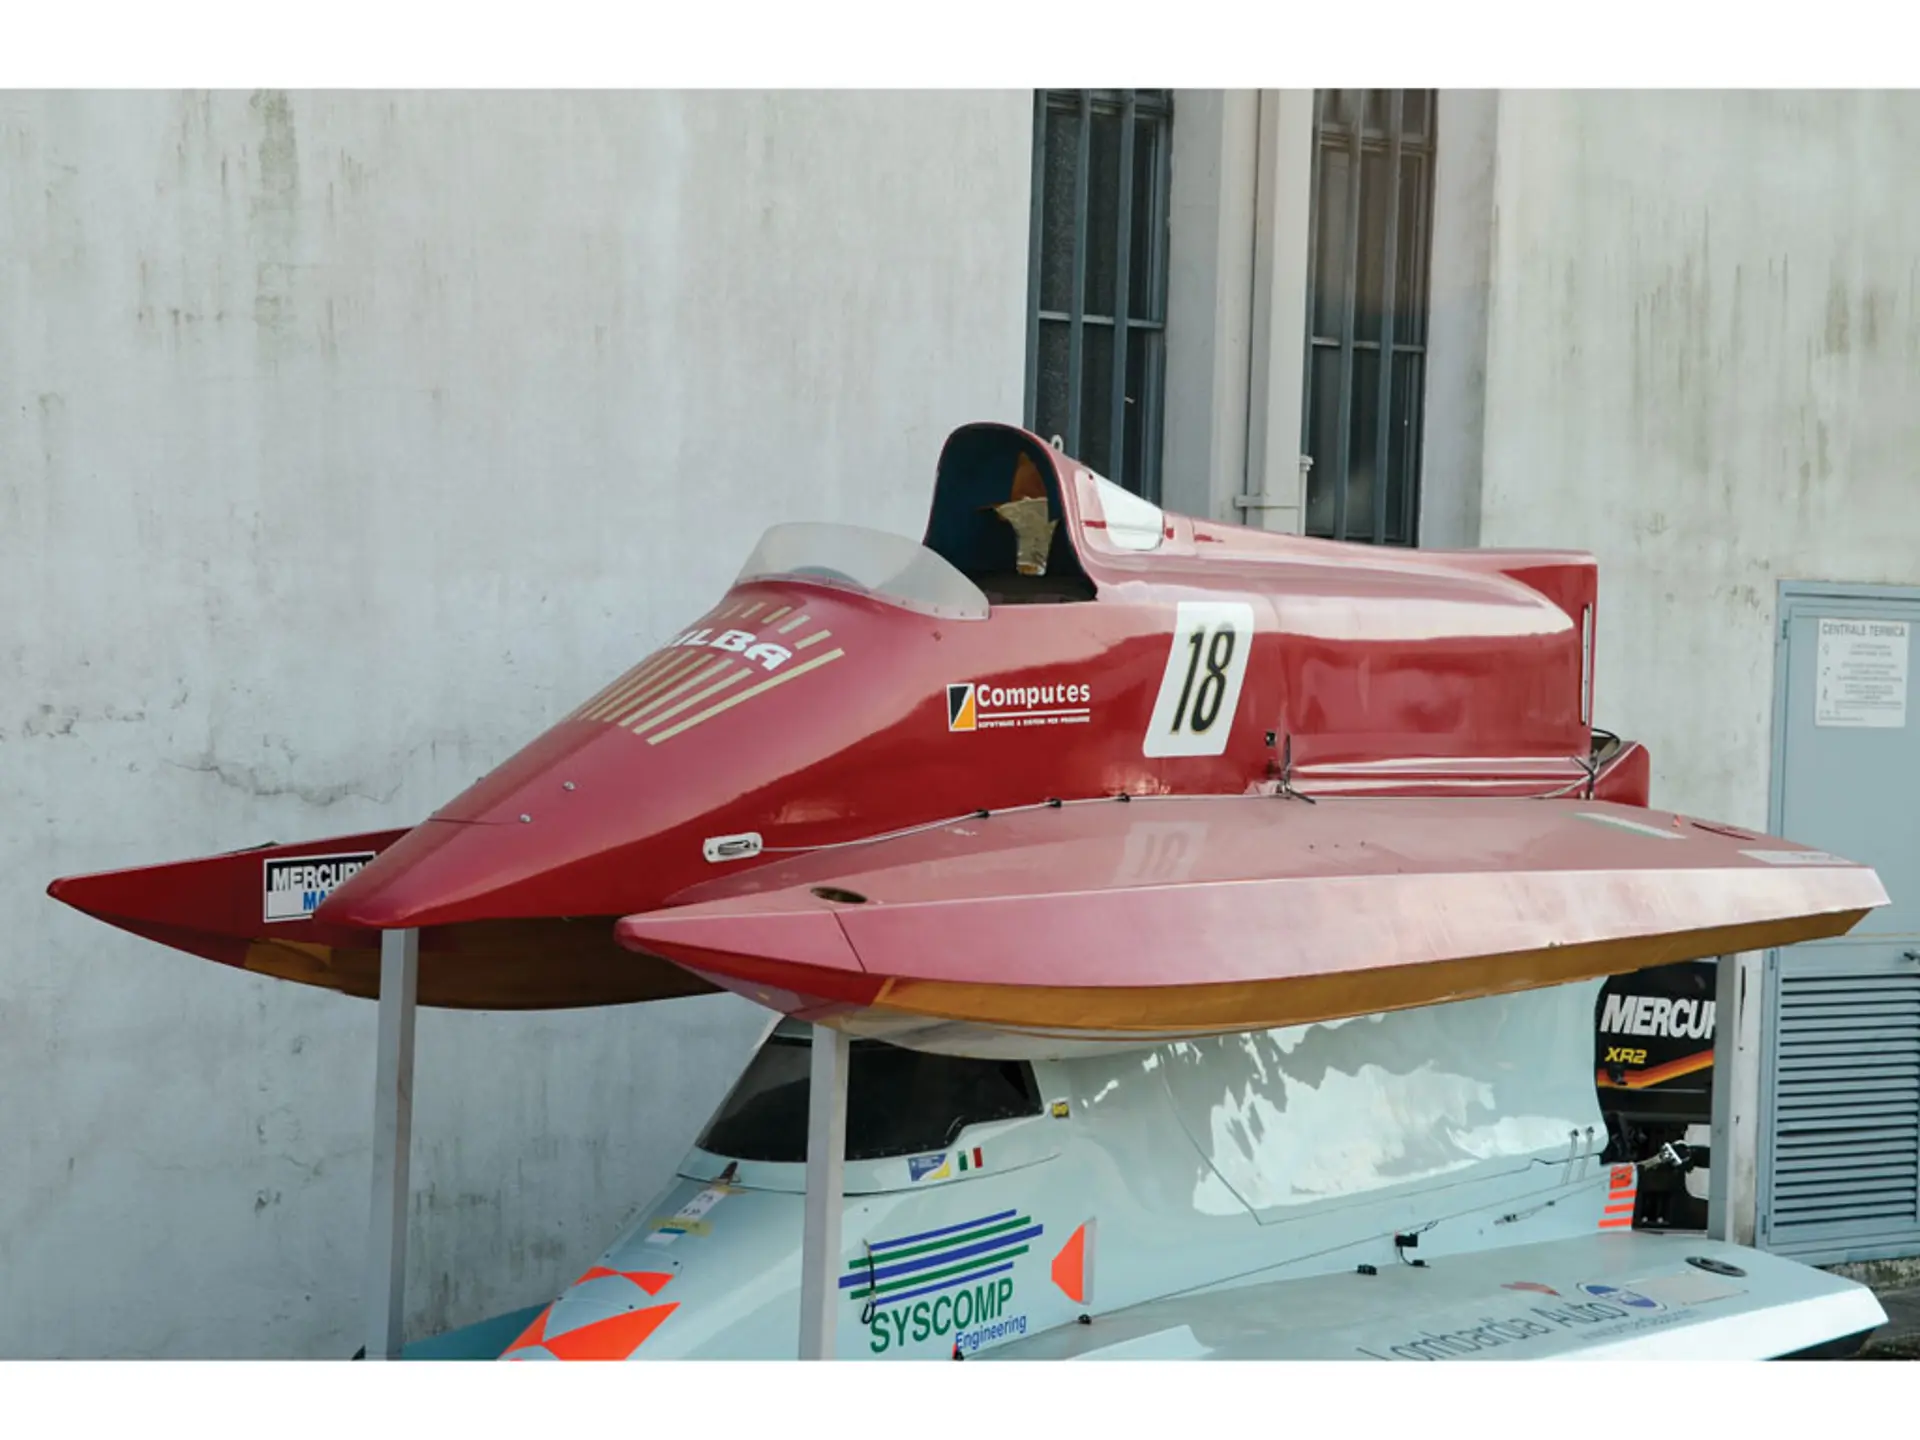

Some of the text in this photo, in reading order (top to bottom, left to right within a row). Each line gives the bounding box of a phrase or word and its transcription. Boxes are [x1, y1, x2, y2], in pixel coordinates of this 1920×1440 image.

[667, 628, 793, 671] ILBA
[976, 683, 1091, 709] Computes
[1169, 620, 1236, 736] 18
[272, 861, 366, 892] MERCUR
[1604, 1047, 1647, 1064] XR2
[870, 1277, 1013, 1353] SYSCOMP
[955, 1315, 1027, 1351] Engineering
